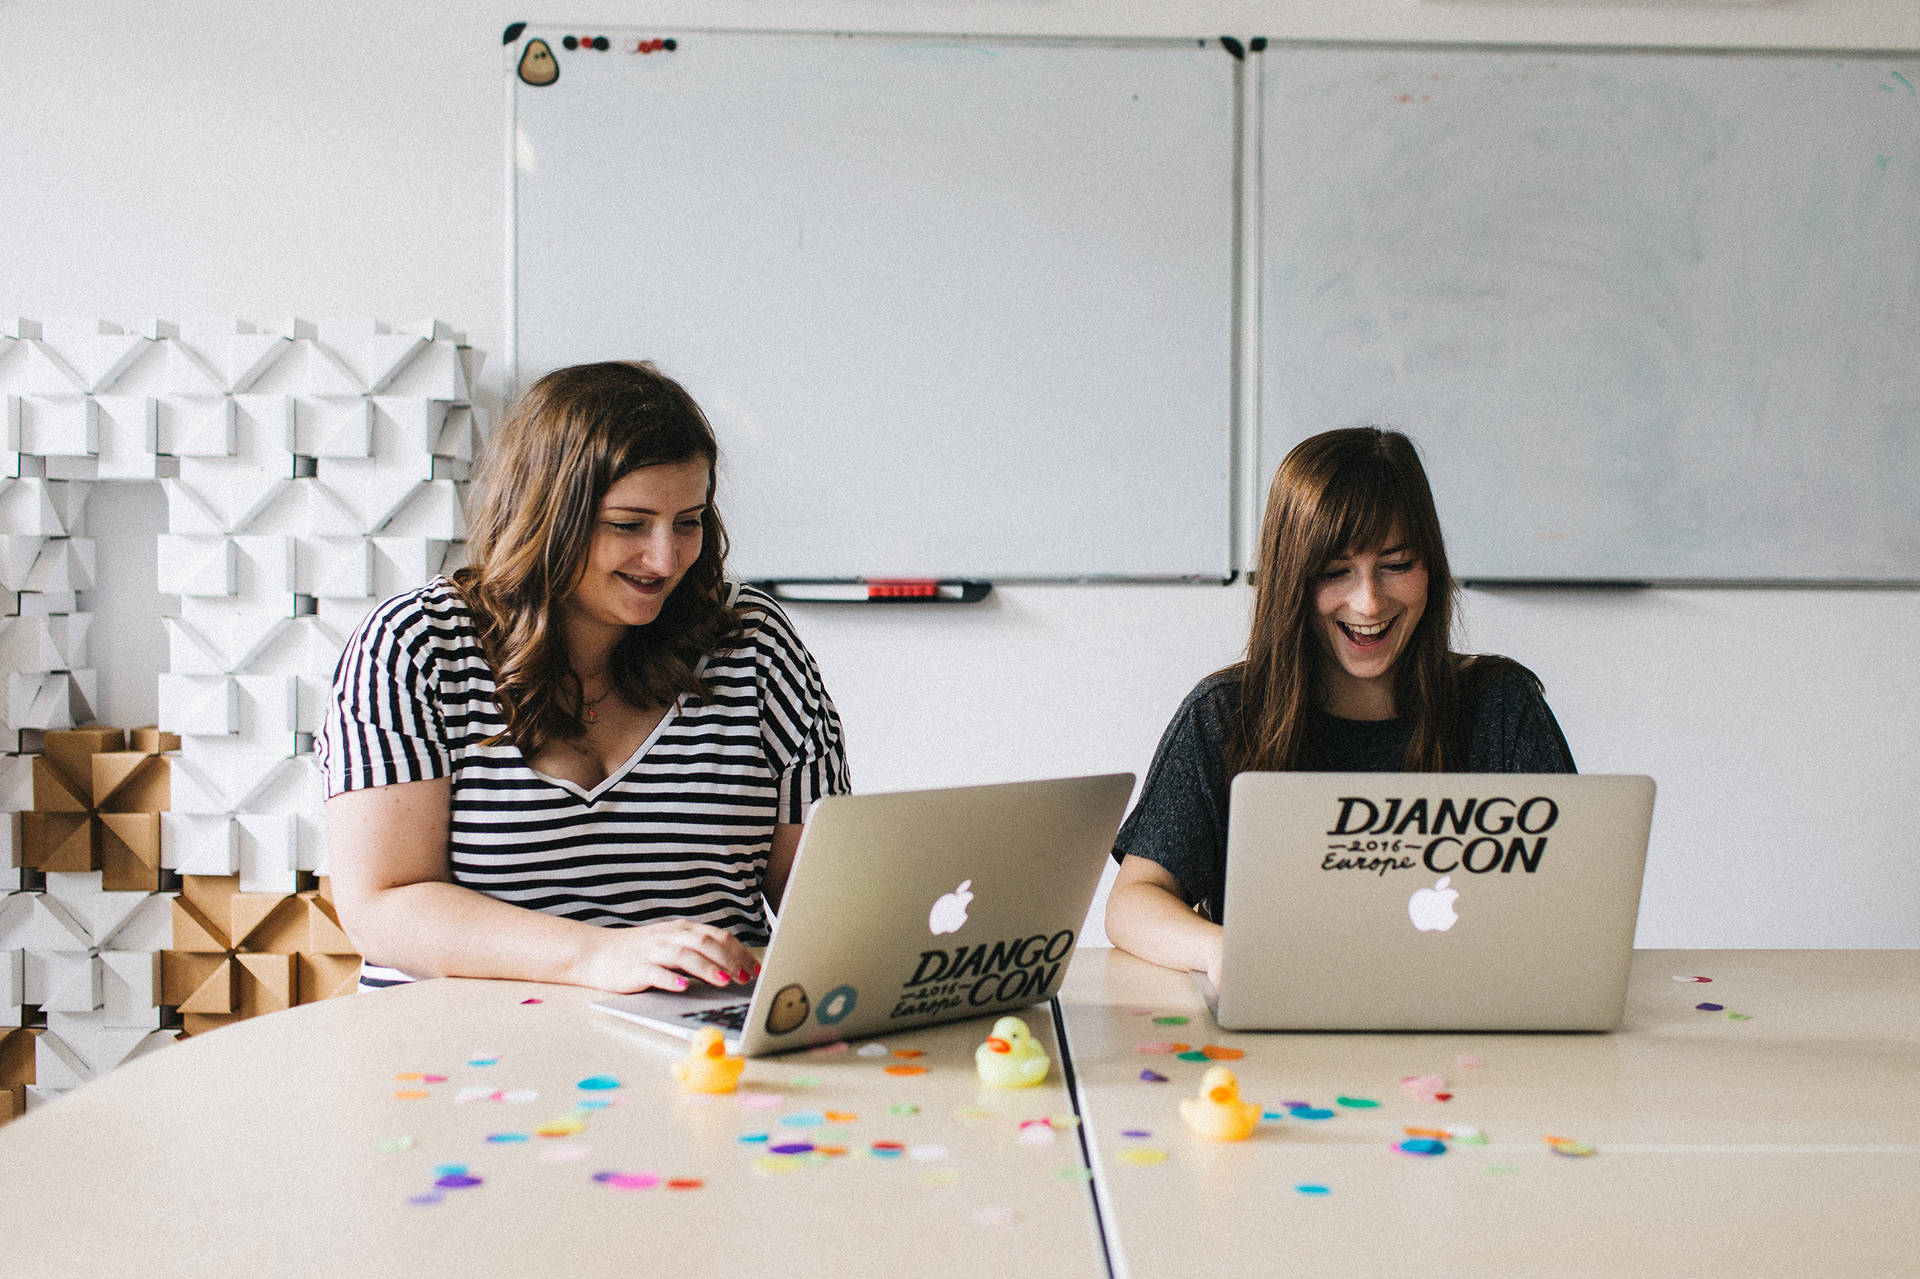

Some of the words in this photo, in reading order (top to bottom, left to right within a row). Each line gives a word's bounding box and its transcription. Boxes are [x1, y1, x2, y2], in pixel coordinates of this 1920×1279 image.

[1326, 796, 1559, 836] DJANGO
[1321, 852, 1417, 877] Europe
[1422, 836, 1548, 874] CON
[903, 929, 1074, 988] DJANGO
[968, 963, 1060, 1007] CON
[890, 998, 963, 1020] Europe
